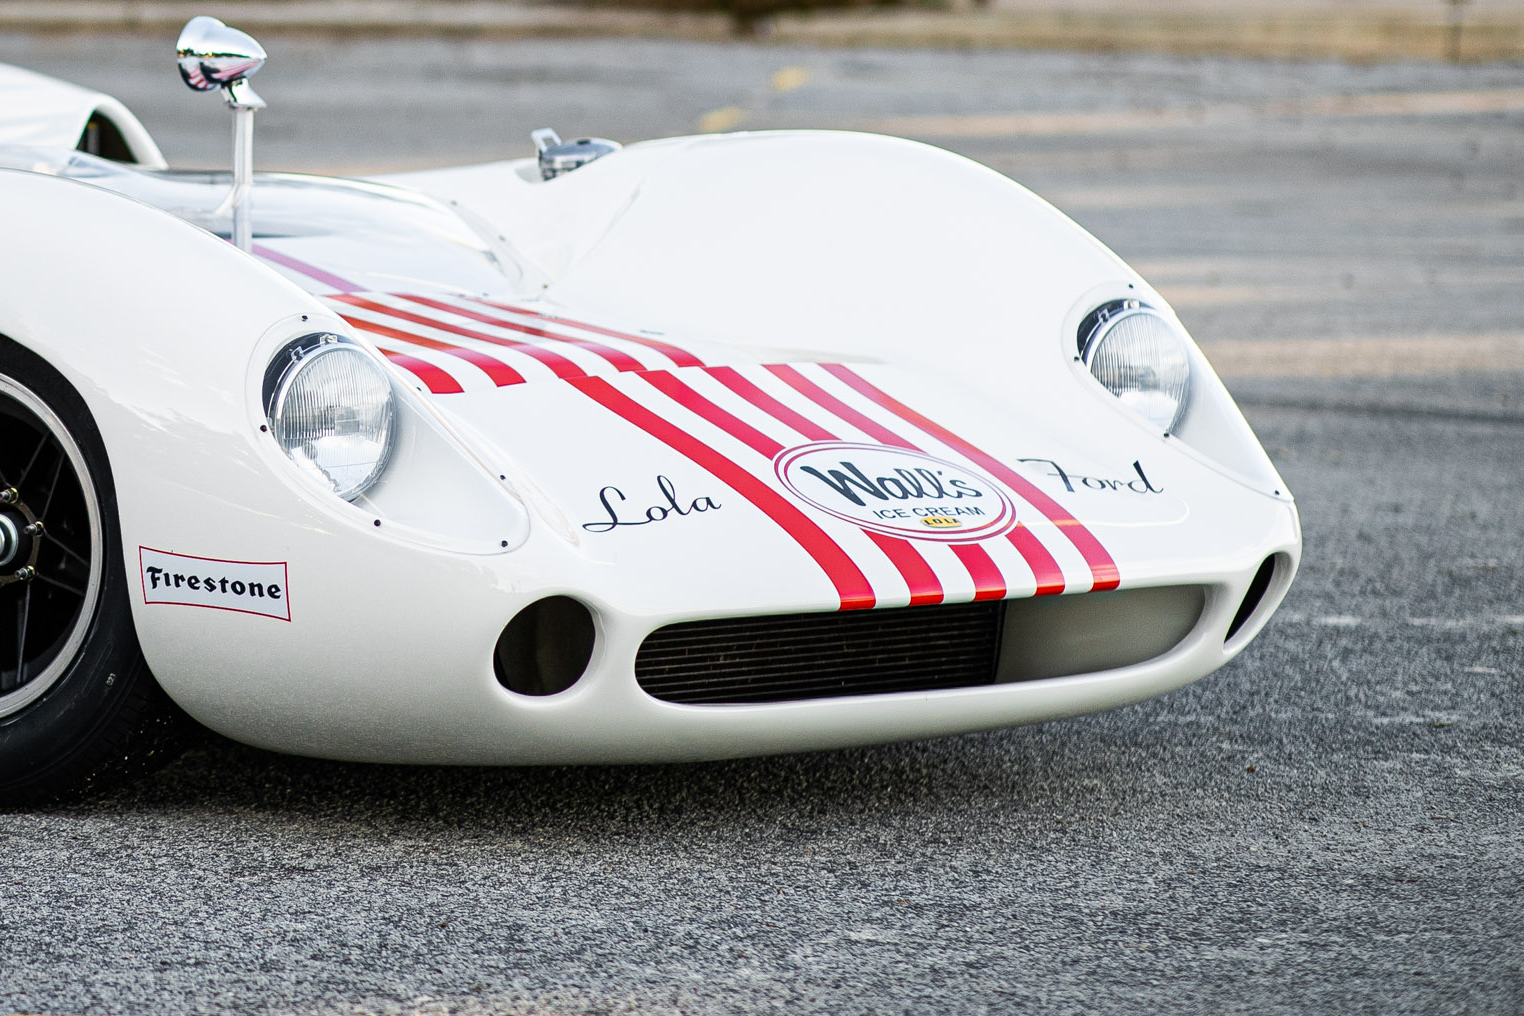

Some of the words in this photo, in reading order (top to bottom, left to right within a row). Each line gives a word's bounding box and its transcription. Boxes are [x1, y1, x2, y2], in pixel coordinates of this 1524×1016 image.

[799, 461, 984, 507] Wall's
[1015, 457, 1165, 494] Ford
[581, 474, 722, 533] Lola
[872, 509, 912, 520] ICE
[912, 506, 986, 518] CREAM
[146, 565, 282, 600] Firestone
